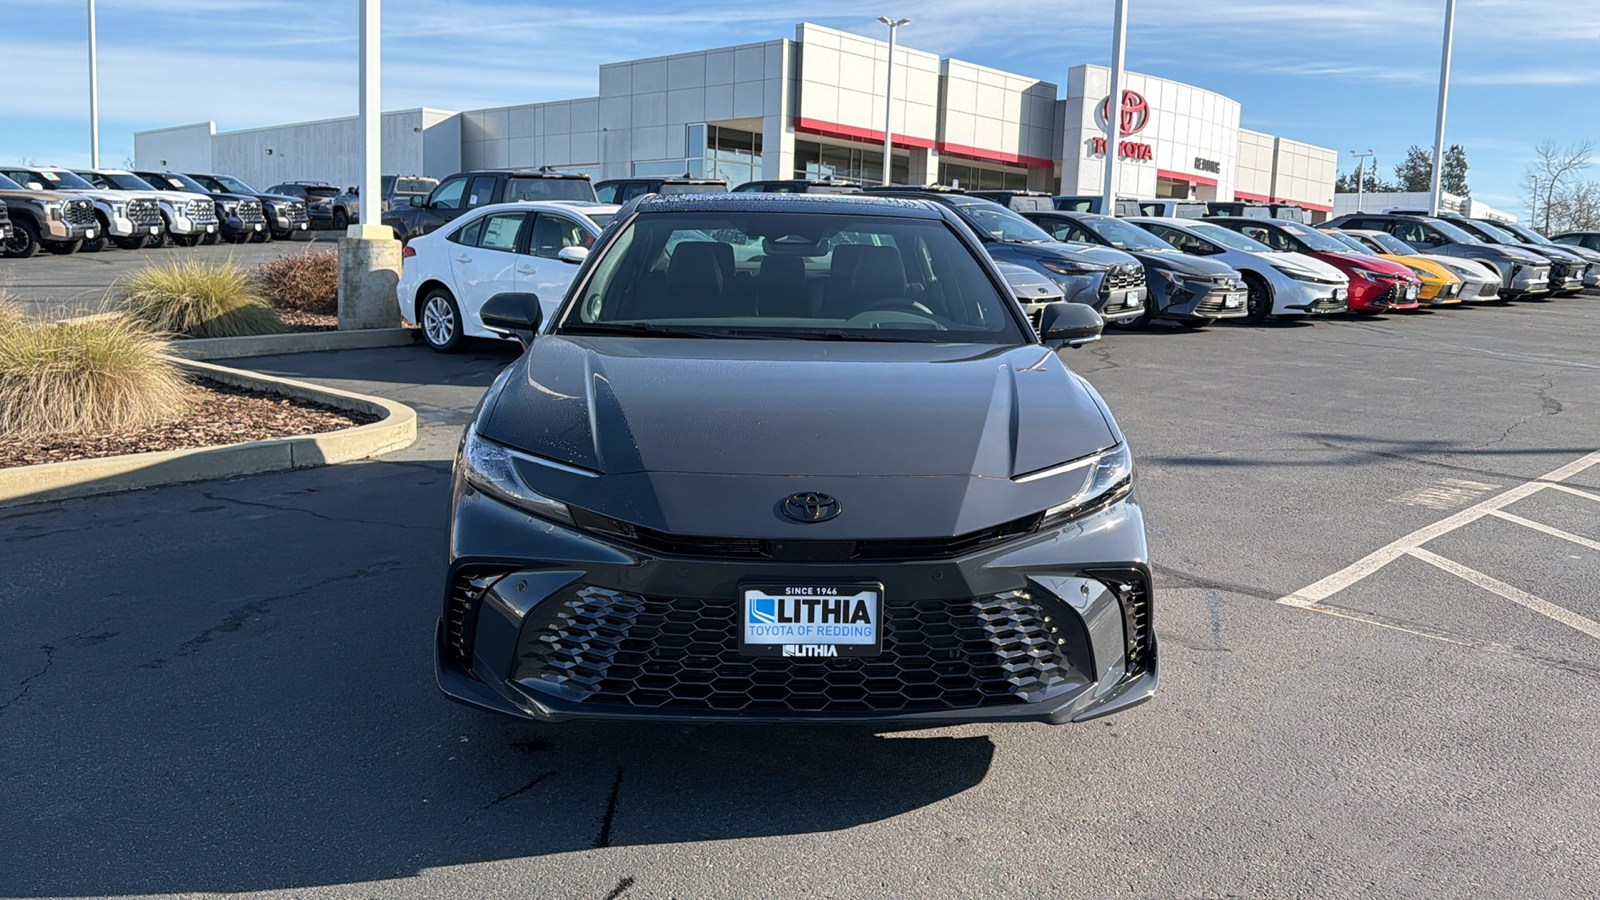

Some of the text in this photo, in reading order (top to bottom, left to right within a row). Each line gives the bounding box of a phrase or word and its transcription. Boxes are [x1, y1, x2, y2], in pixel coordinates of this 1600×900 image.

[785, 587, 838, 595] SINCE 1946
[777, 599, 871, 624] LITHIA
[749, 625, 872, 637] TOYOTA OF REDDING
[795, 645, 838, 657] LITHIA
